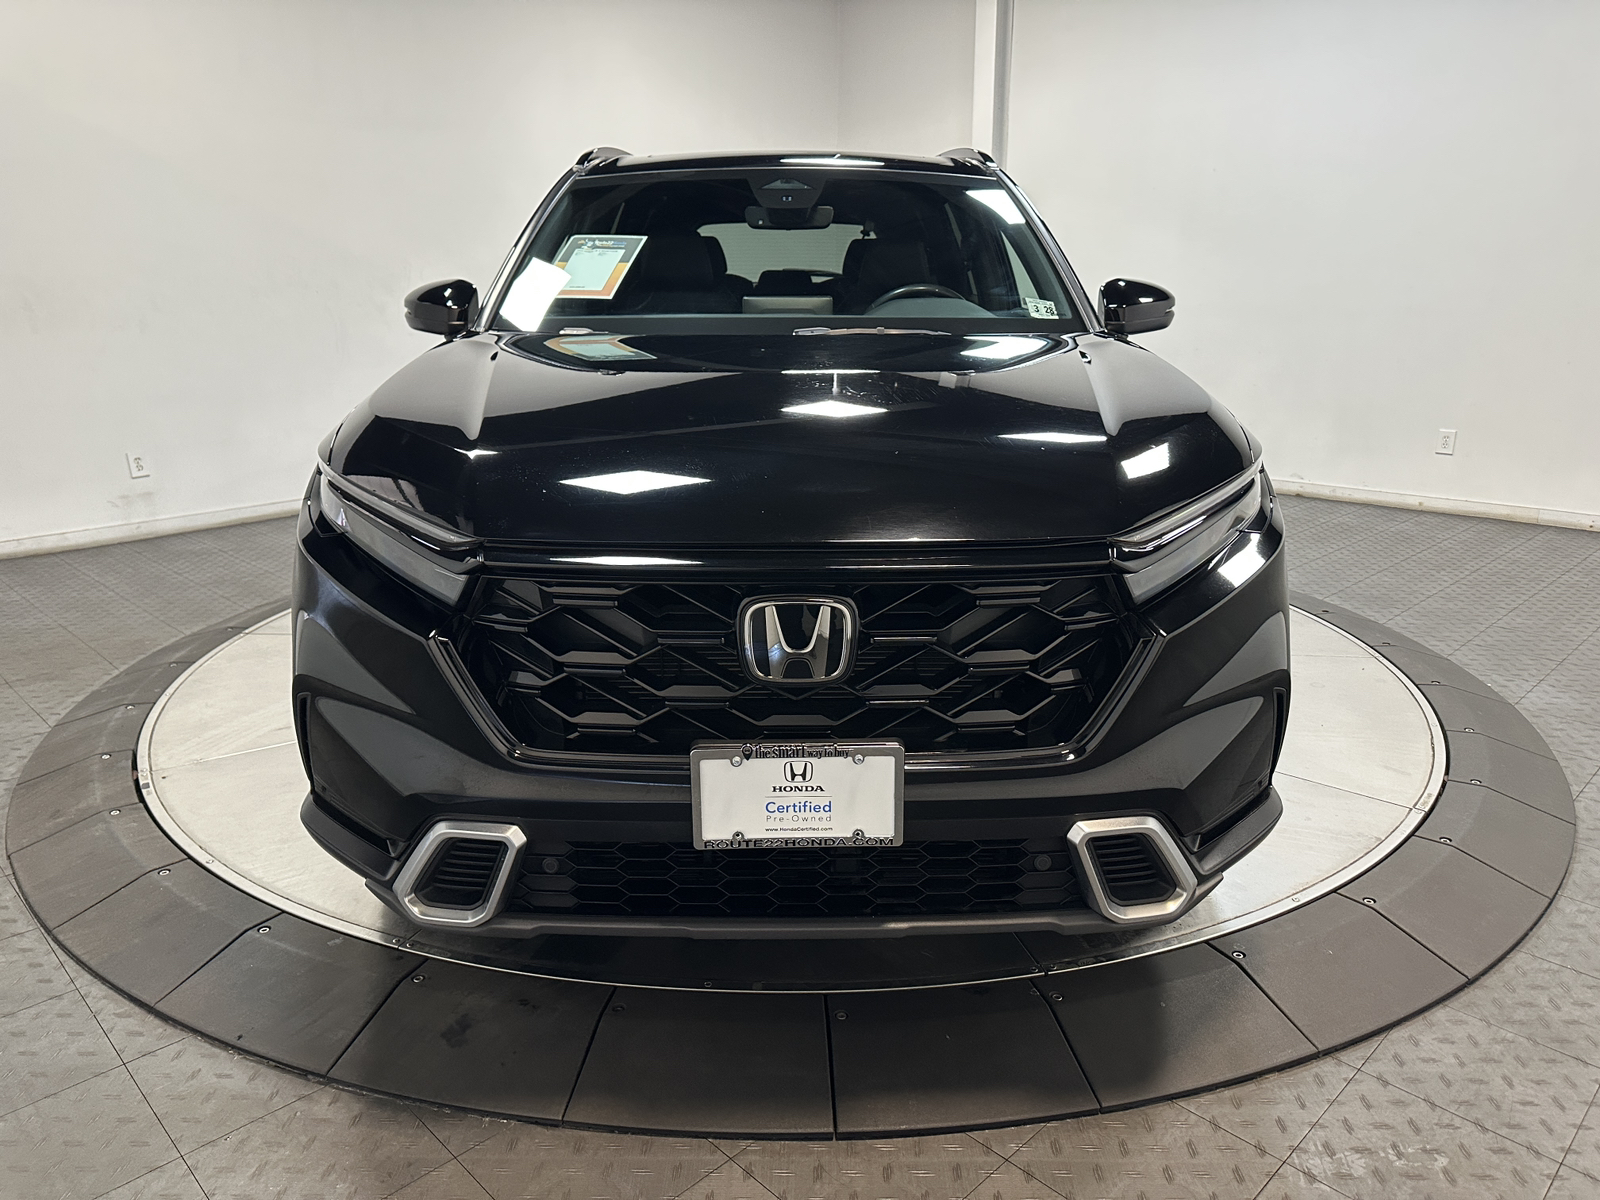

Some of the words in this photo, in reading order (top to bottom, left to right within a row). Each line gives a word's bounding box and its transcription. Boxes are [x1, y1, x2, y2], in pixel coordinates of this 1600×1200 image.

[756, 744, 770, 758] the
[772, 744, 806, 758] smart
[807, 750, 822, 759] way
[834, 746, 849, 758] buy
[765, 801, 832, 813] Certified
[704, 838, 894, 849] ROUTE22HONDA.COM
